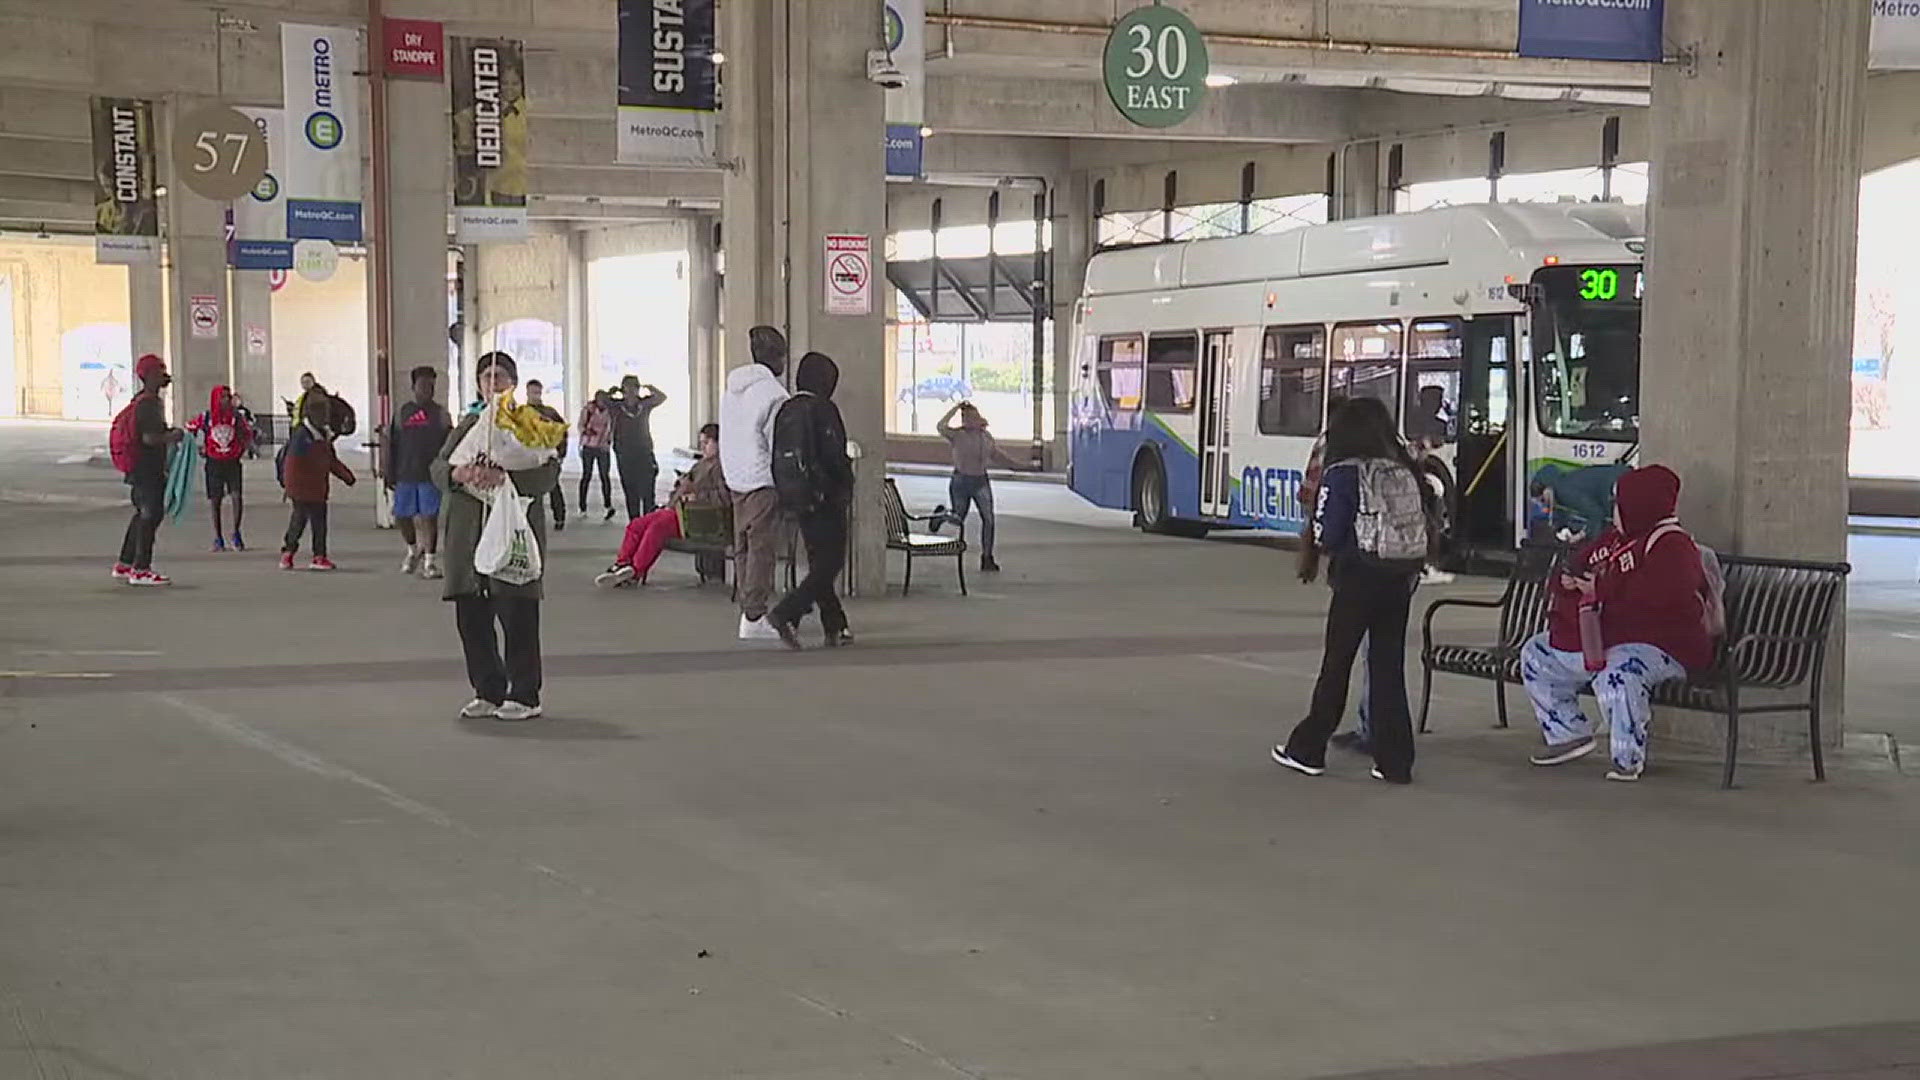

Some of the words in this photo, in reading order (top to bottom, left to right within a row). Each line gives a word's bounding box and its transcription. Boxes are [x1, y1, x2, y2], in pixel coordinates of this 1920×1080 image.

[1873, 0, 1920, 17] Metro
[404, 33, 423, 47] DRY
[653, 0, 685, 94] SUSTA
[1125, 23, 1187, 81] 30
[313, 37, 330, 107] METRO
[392, 49, 436, 65] STANDPIPE
[473, 47, 501, 168] DEDICATED
[1126, 86, 1190, 110] EAST
[630, 123, 705, 140] MetroQC.com
[112, 106, 138, 203] CONSTANT
[193, 130, 248, 176] 57
[294, 208, 356, 222] MetroQC.com
[1580, 269, 1618, 300] 30
[1572, 443, 1605, 458] 1612
[1240, 465, 1304, 522] METR
